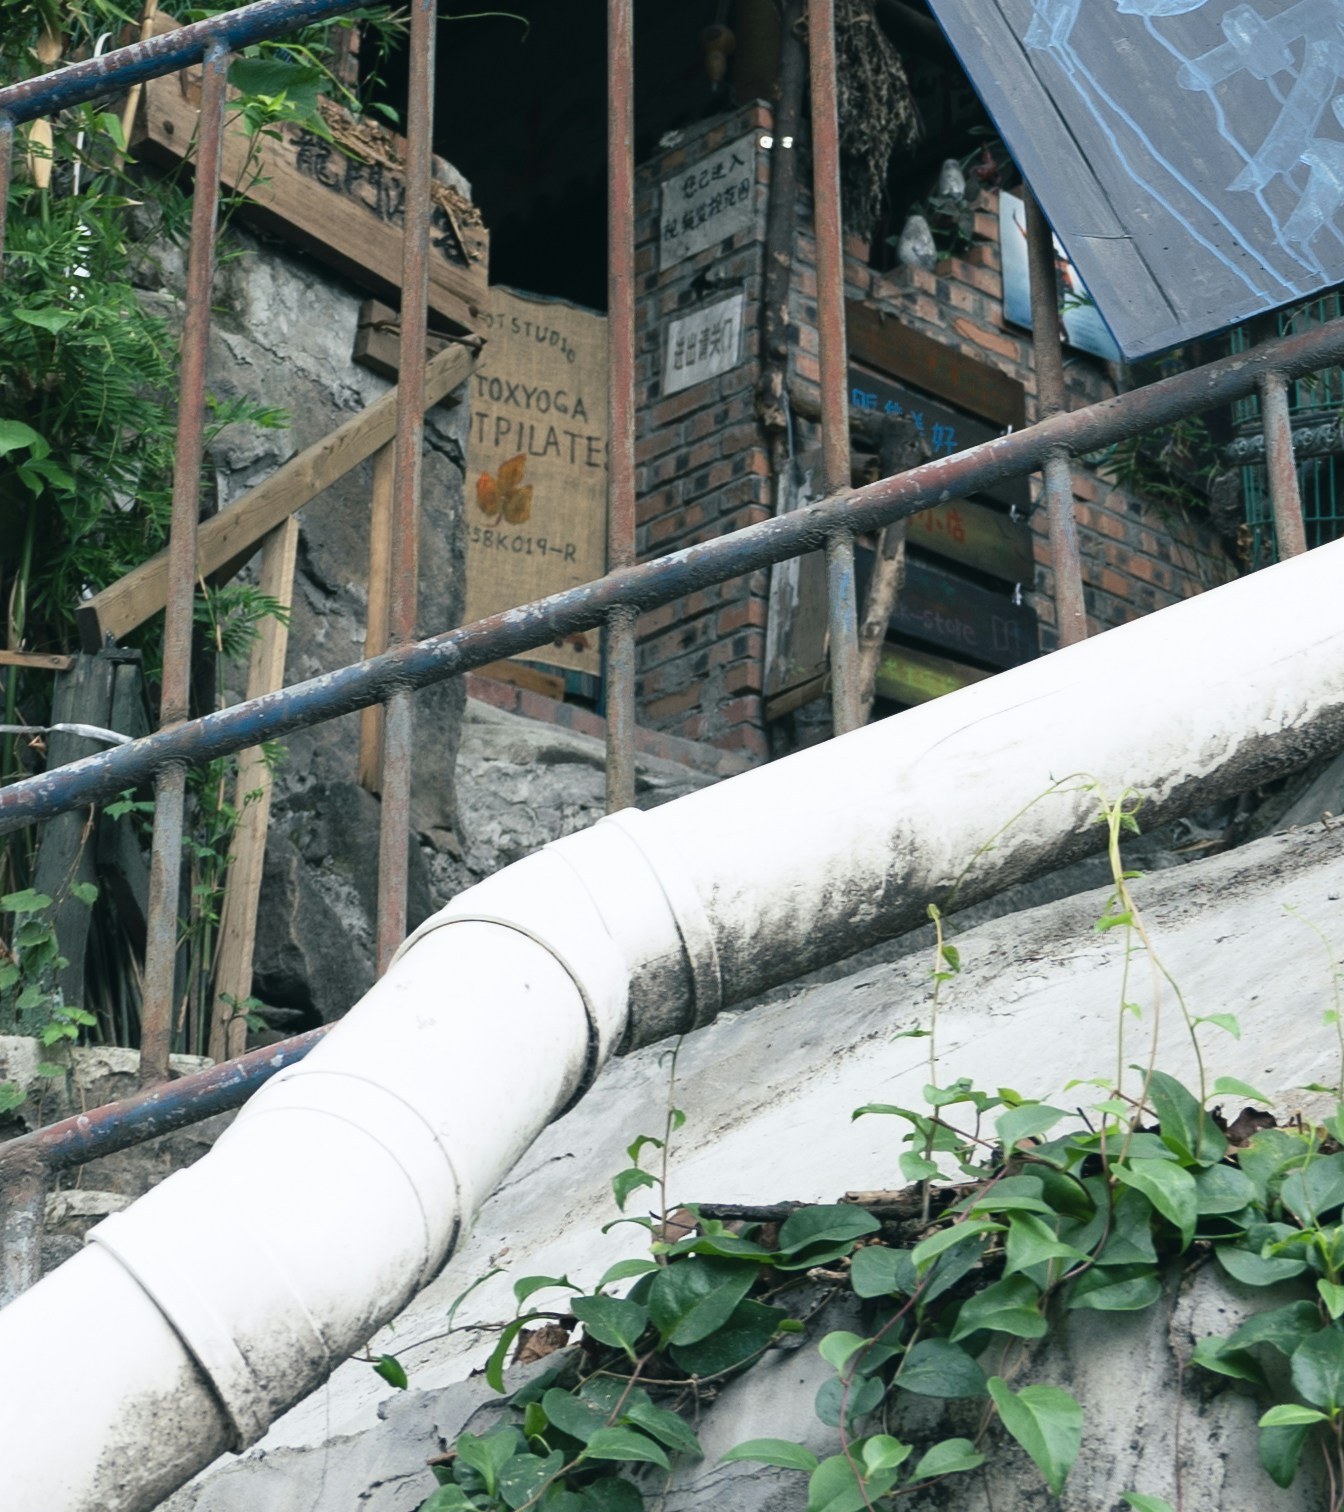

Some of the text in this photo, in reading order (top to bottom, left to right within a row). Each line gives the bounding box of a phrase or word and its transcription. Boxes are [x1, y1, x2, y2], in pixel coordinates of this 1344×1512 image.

[511, 316, 576, 364] STUDIO
[674, 317, 734, 370] 进出请关门
